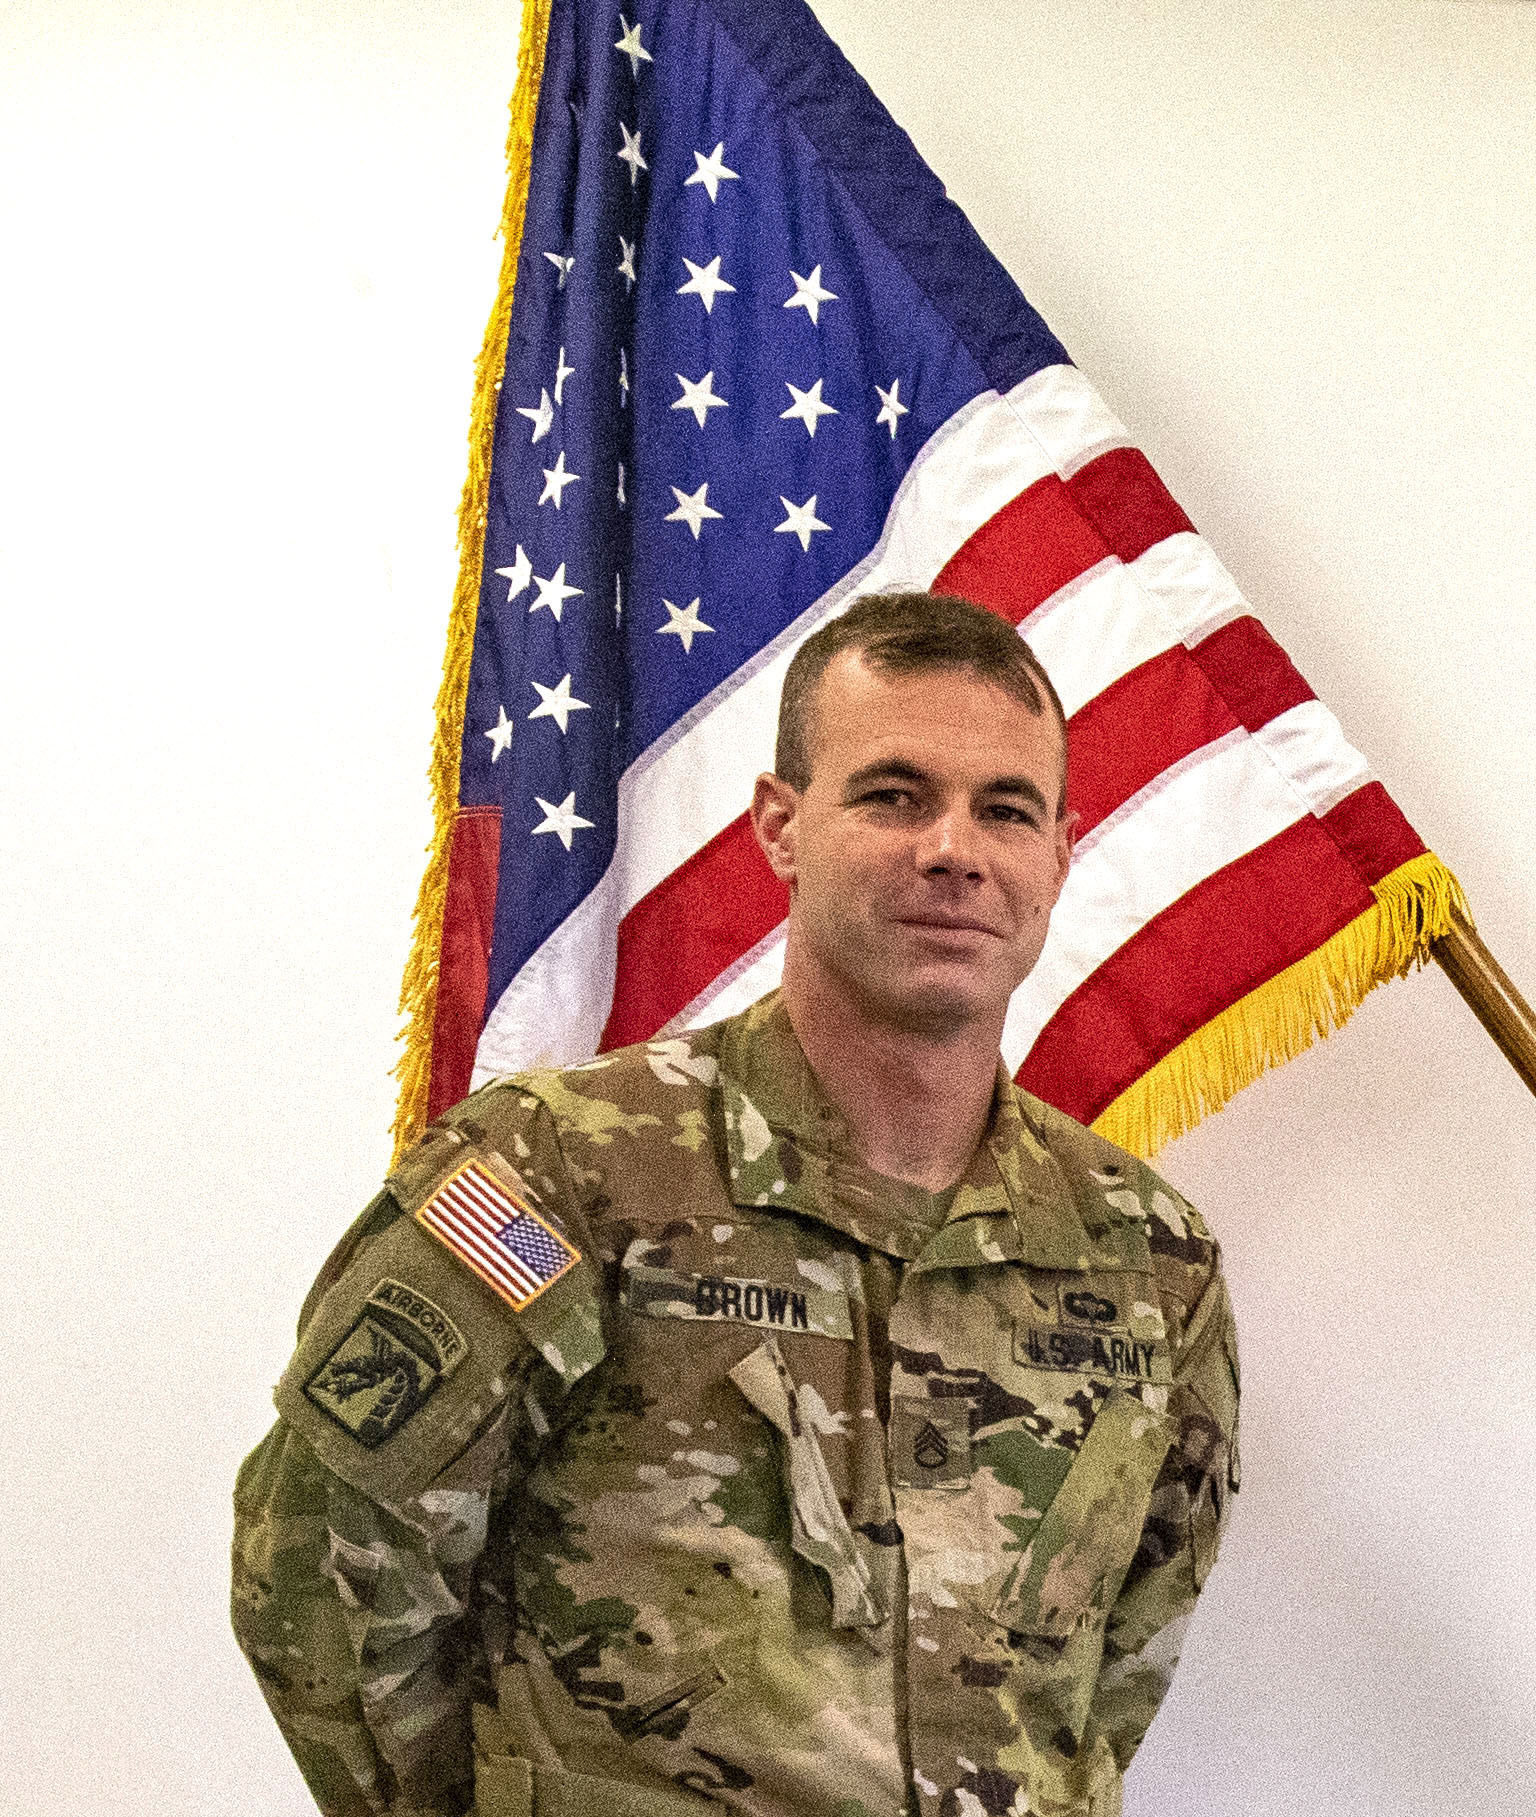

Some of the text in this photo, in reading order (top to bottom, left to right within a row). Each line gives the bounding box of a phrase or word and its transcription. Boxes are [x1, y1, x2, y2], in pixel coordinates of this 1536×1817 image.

[375, 1284, 460, 1360] AIRBORNE
[695, 1276, 809, 1330] BROWN
[1089, 1335, 1156, 1378] ARMY
